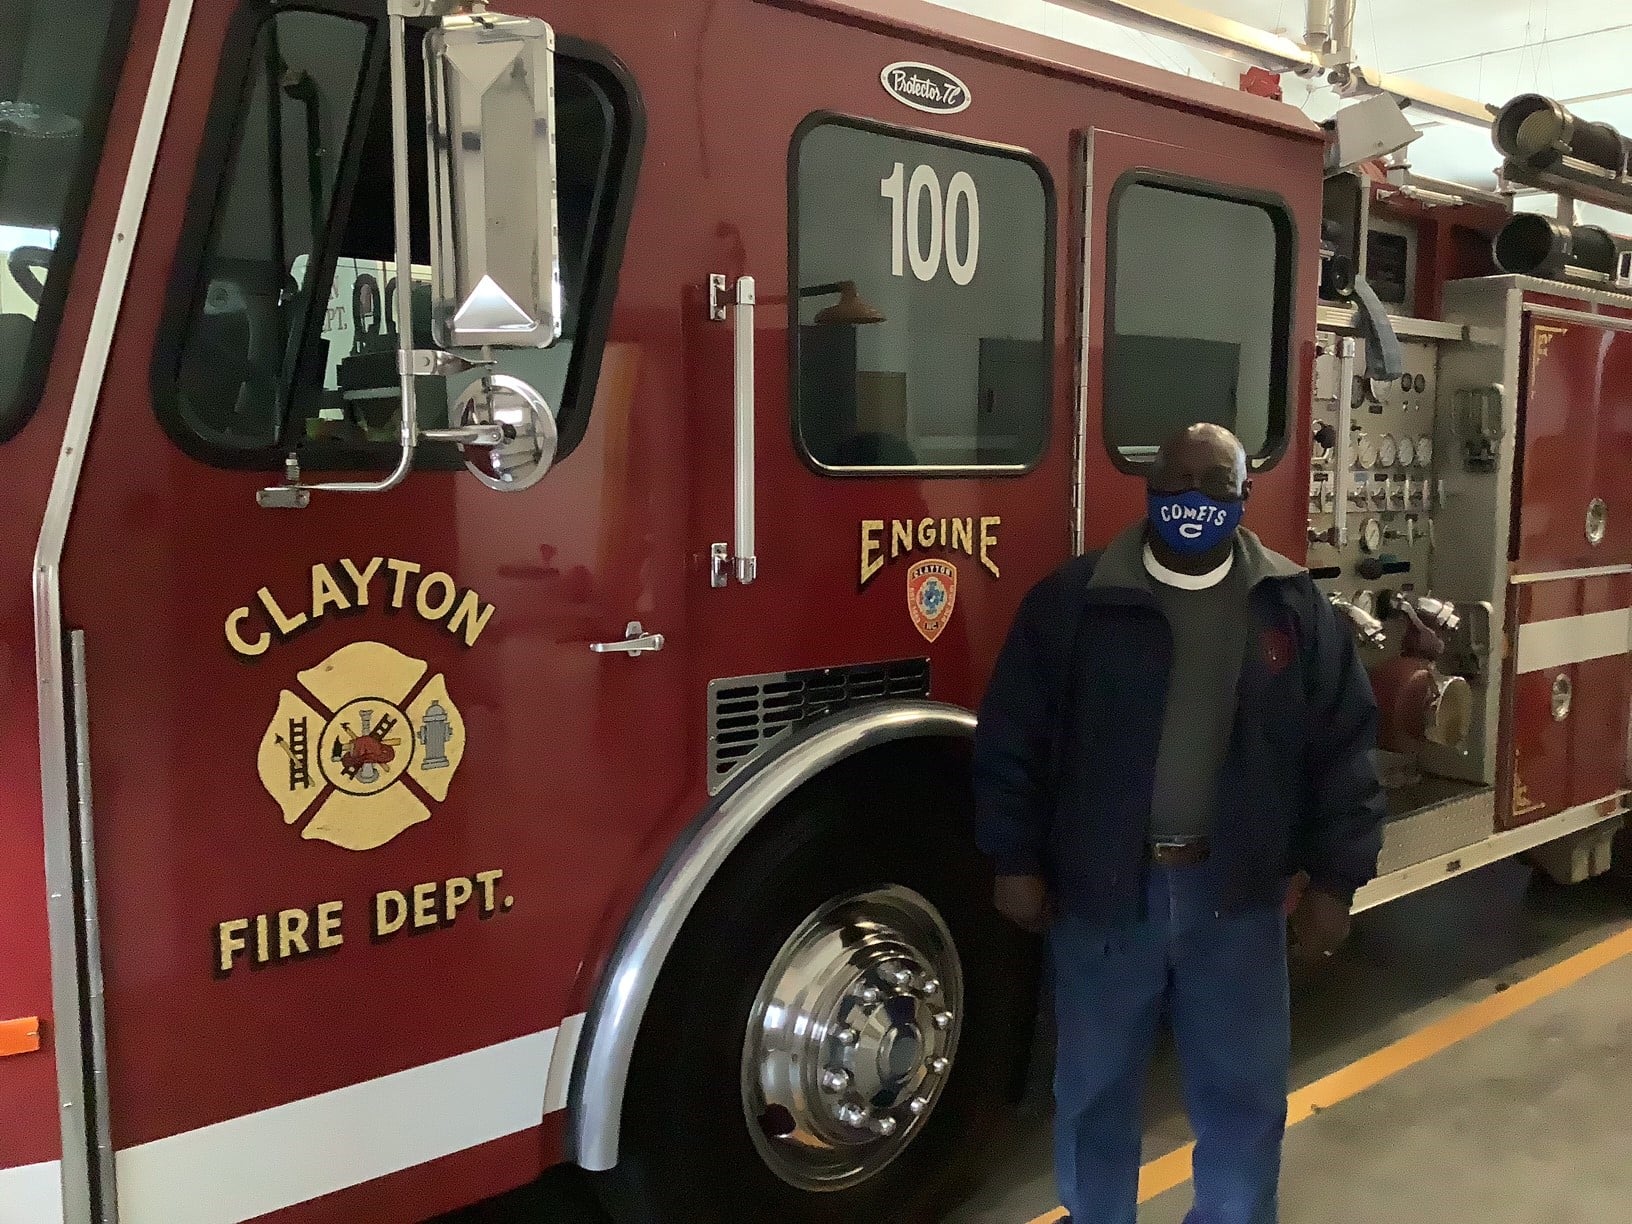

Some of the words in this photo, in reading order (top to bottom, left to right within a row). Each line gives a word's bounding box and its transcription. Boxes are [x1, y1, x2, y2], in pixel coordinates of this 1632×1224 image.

[891, 69, 942, 102] Protector
[880, 161, 980, 286] 100
[1160, 503, 1227, 526] COMETS
[1178, 523, 1203, 539] C
[860, 515, 1001, 584] ENGINE
[913, 564, 952, 579] CLAYTON
[224, 556, 496, 657] CLAYTON
[218, 900, 344, 971] FIRE
[375, 868, 515, 937] DEPT.
